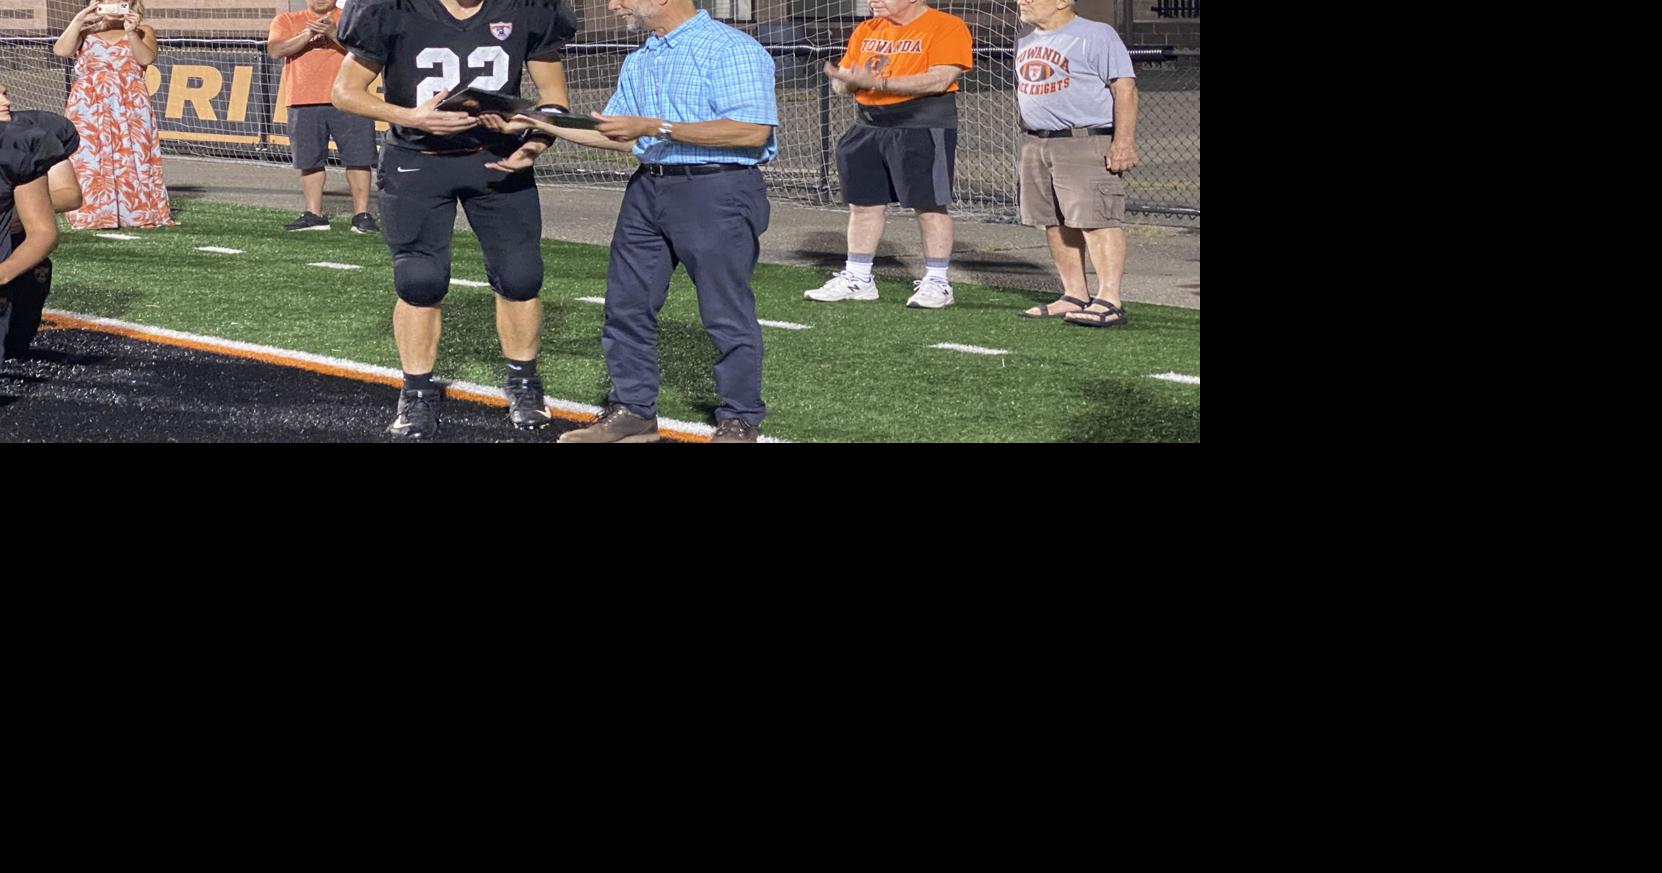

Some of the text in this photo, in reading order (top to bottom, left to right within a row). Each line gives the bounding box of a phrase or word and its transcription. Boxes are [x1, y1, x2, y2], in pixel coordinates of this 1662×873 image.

[861, 39, 922, 54] TOWANDA
[416, 46, 509, 108] 22
[1030, 77, 1070, 95] KNIGHTS
